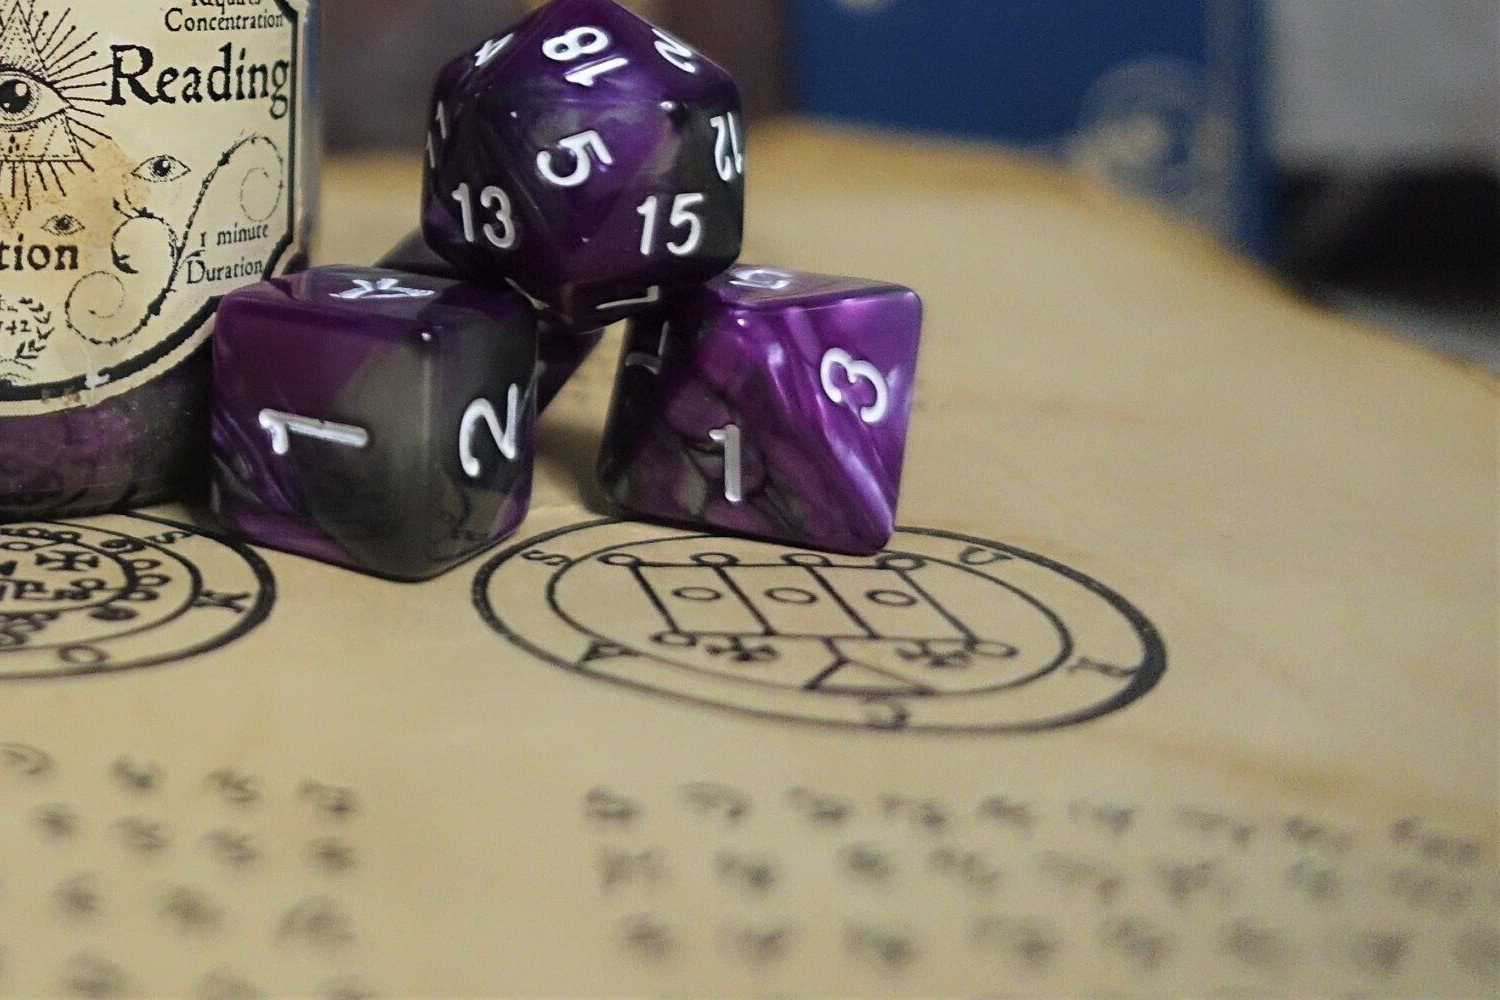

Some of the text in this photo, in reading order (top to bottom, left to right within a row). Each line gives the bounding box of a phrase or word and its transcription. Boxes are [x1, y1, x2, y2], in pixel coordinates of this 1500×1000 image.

[164, 6, 284, 33] Concentration
[107, 41, 290, 120] Reading
[536, 129, 614, 187] 5
[216, 221, 269, 247] minute
[452, 182, 517, 249] 13
[636, 192, 705, 256] 15
[186, 256, 265, 286] Duration
[820, 346, 891, 426] 3
[257, 407, 369, 455] 1
[459, 383, 518, 478] 2
[710, 423, 741, 503] 1
